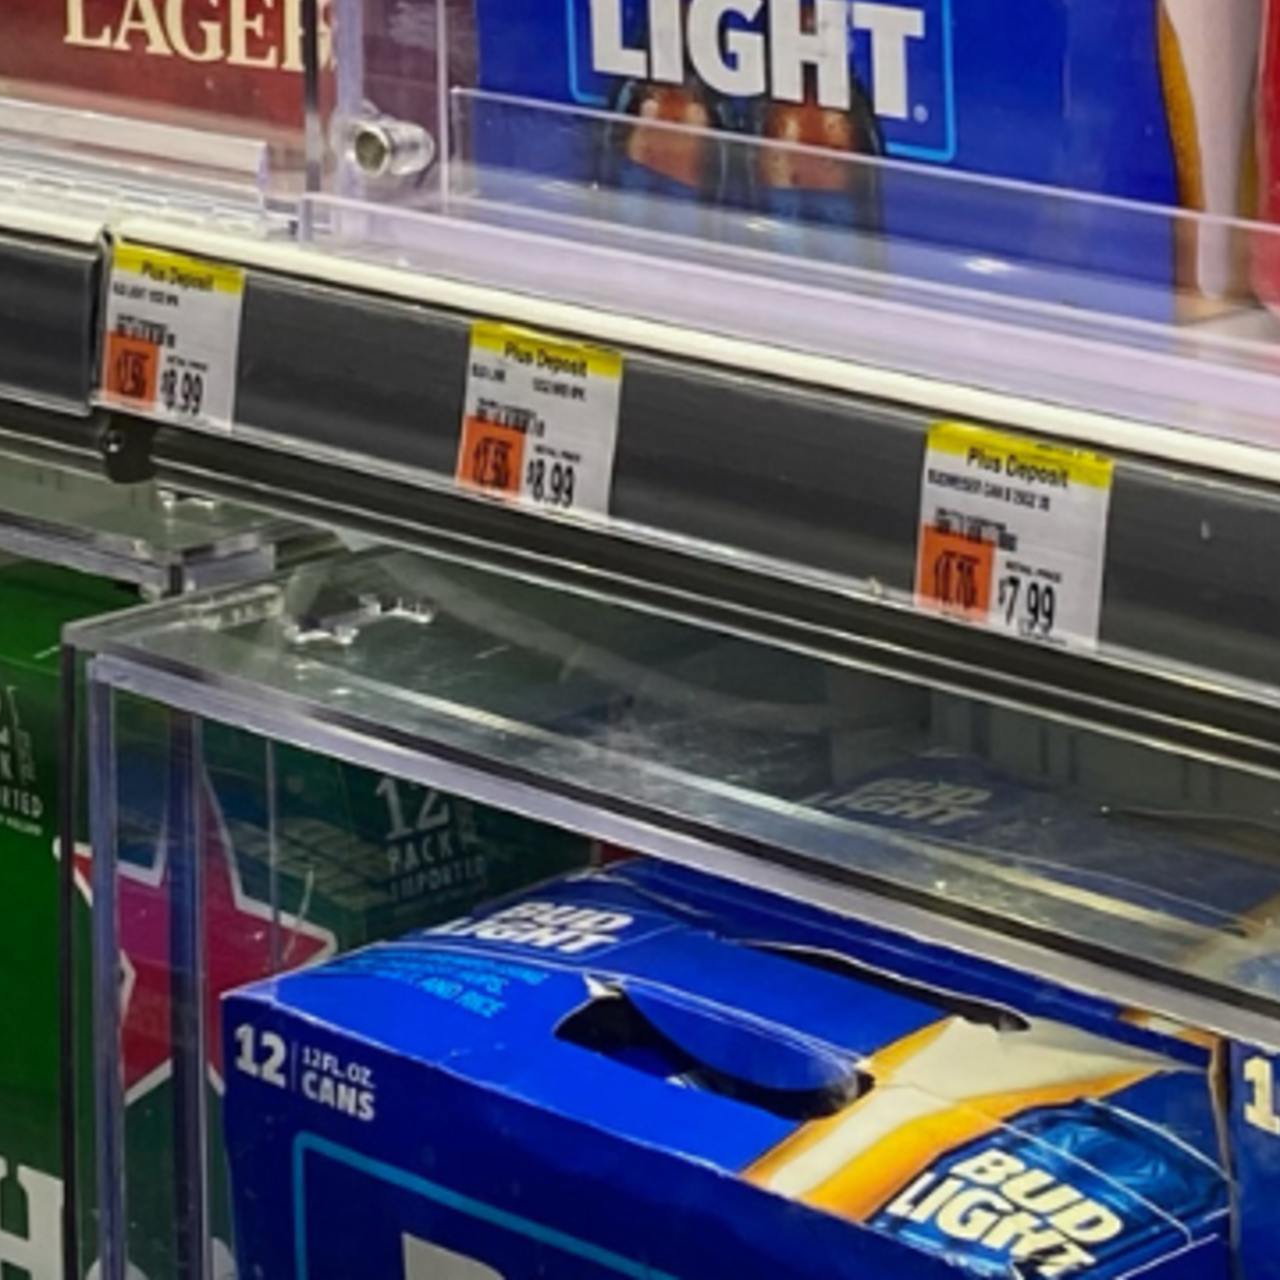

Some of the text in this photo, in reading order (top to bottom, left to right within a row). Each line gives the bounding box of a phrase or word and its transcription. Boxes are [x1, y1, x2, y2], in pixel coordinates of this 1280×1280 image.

[504, 341, 589, 378] Plus Deposit
[966, 446, 1070, 489] Plus Deposit
[386, 830, 454, 878] PACK
[425, 916, 620, 954] LIGHT
[505, 900, 634, 931] BUD
[234, 1022, 288, 1090] 12
[301, 1074, 376, 1122] CANS
[949, 1145, 1124, 1245] BUD
[884, 1168, 1100, 1280] LIGHT
